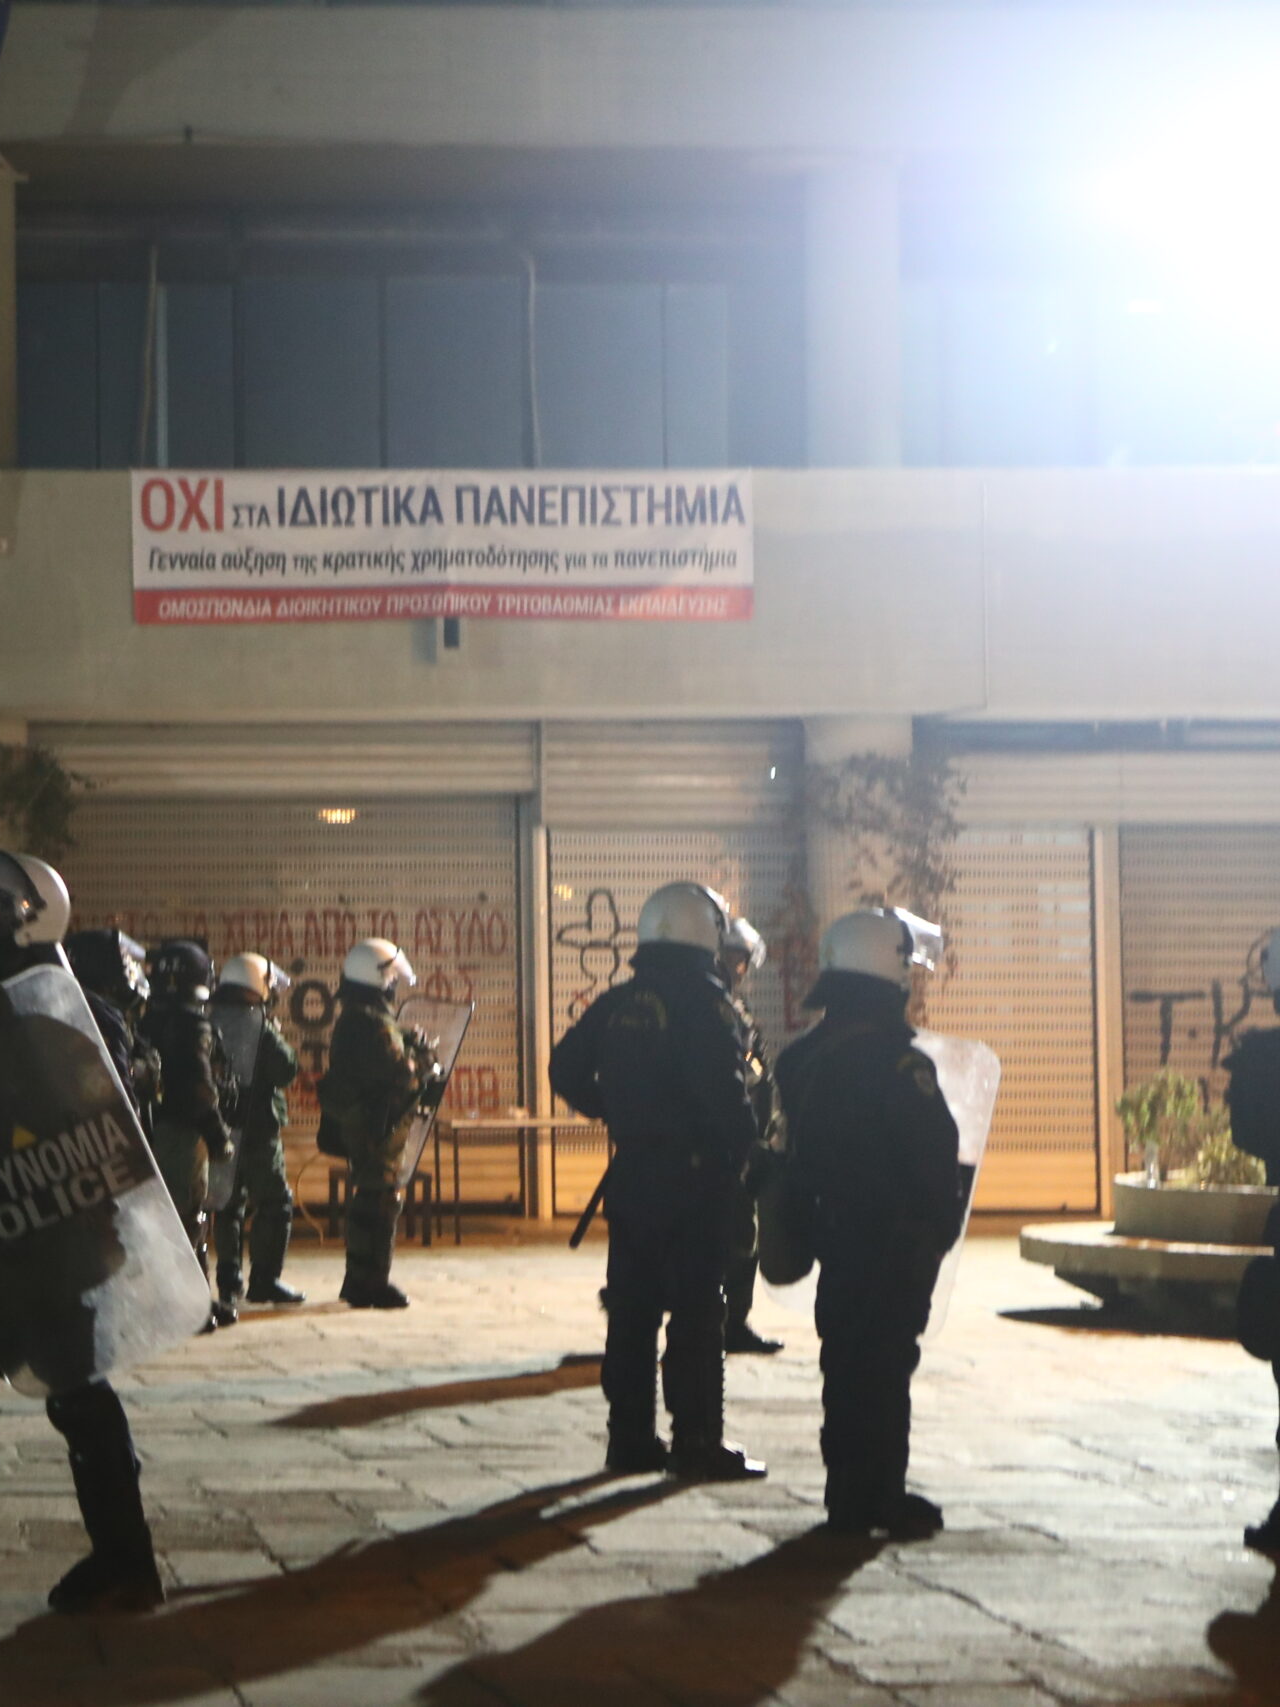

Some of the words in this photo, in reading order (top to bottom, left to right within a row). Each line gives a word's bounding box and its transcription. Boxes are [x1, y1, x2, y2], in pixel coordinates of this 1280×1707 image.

[141, 477, 224, 532] ΟΧΙ
[232, 505, 271, 528] ΣΤΑ
[277, 485, 445, 528] ΙΔΙΩΤΙΚΑ
[454, 483, 747, 527] ΠΑΝΕΠΙΣΤΗΜΙΑ
[148, 545, 216, 572] Γενναία
[221, 545, 288, 577] αύξηση
[292, 555, 319, 574] της
[323, 544, 406, 577] κρατικής
[410, 545, 559, 577] χρηματοδότησης
[563, 552, 587, 572] για
[592, 554, 609, 570] τα
[613, 544, 738, 573] πανεπιστήμια
[158, 596, 272, 619] ΟΜΟΣΠΟΝΔΙΑ
[276, 595, 382, 618] ΔΙΟΙΚΗΤΙΚΟΥ
